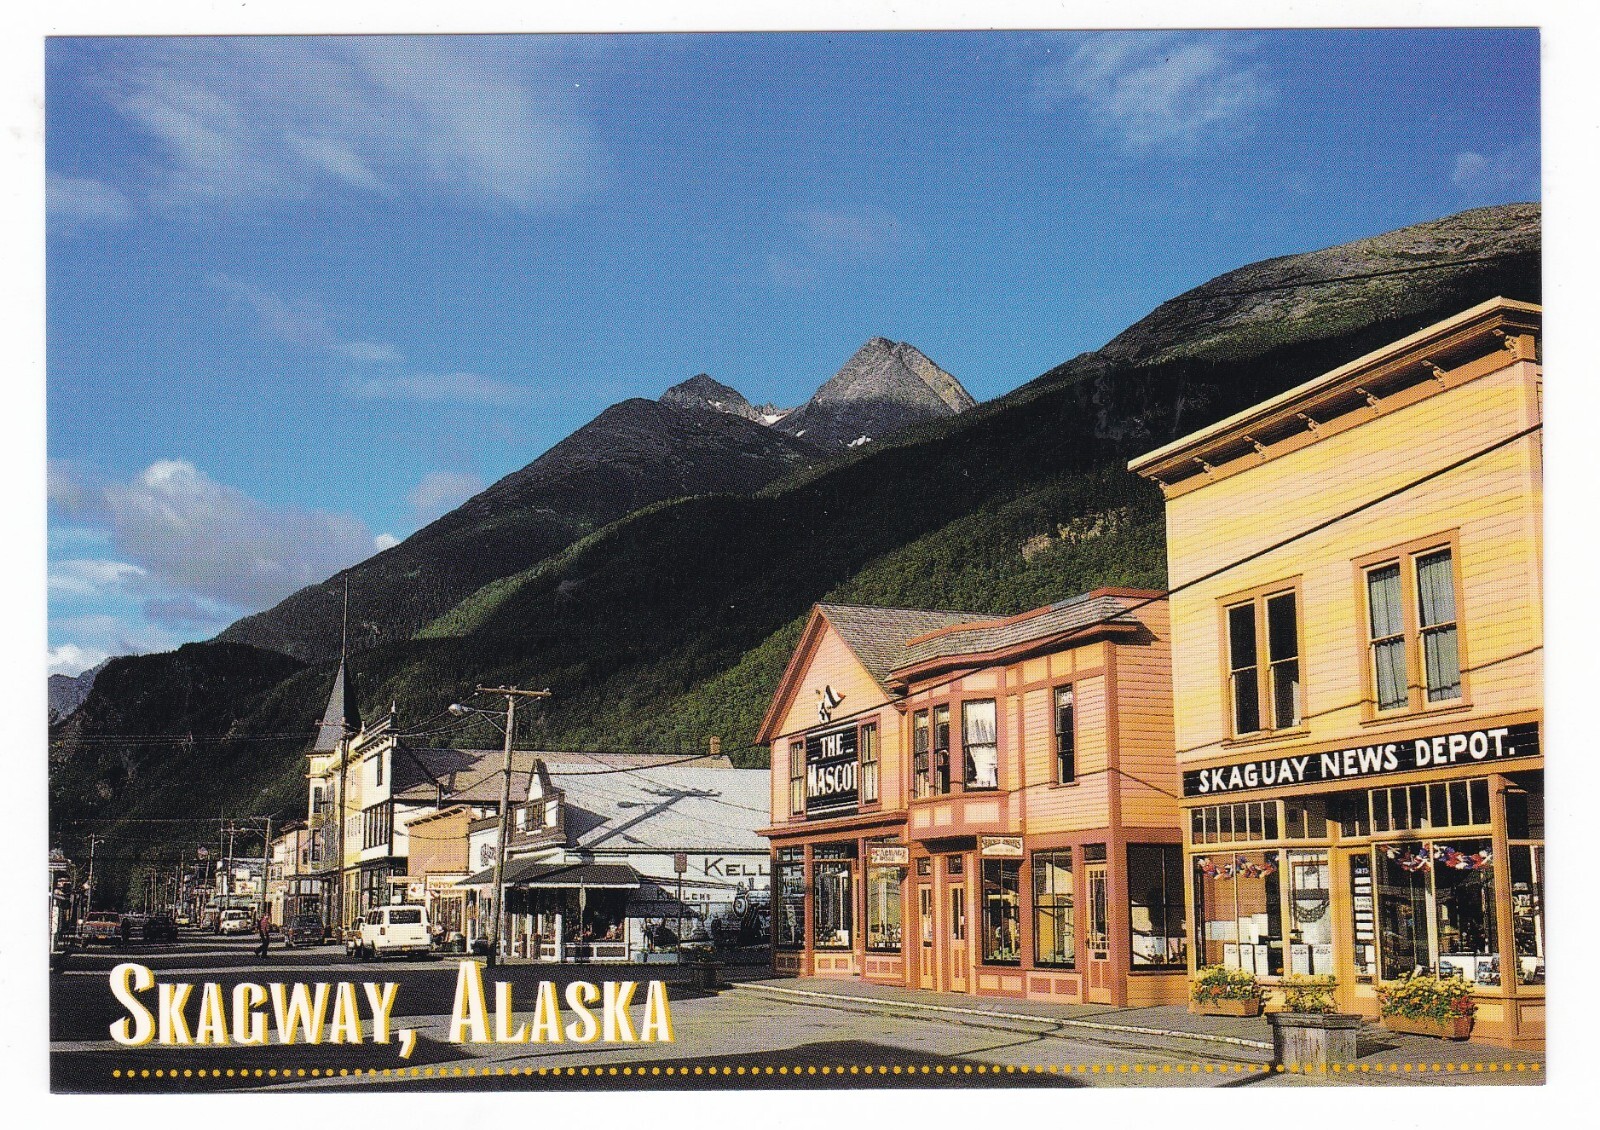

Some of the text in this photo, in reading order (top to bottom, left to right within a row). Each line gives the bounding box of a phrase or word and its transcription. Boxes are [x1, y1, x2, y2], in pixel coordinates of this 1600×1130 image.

[820, 732, 844, 759] THE
[1199, 727, 1516, 793] SKAGUAY NEWS DEPOT.
[806, 760, 859, 798] MASCOT
